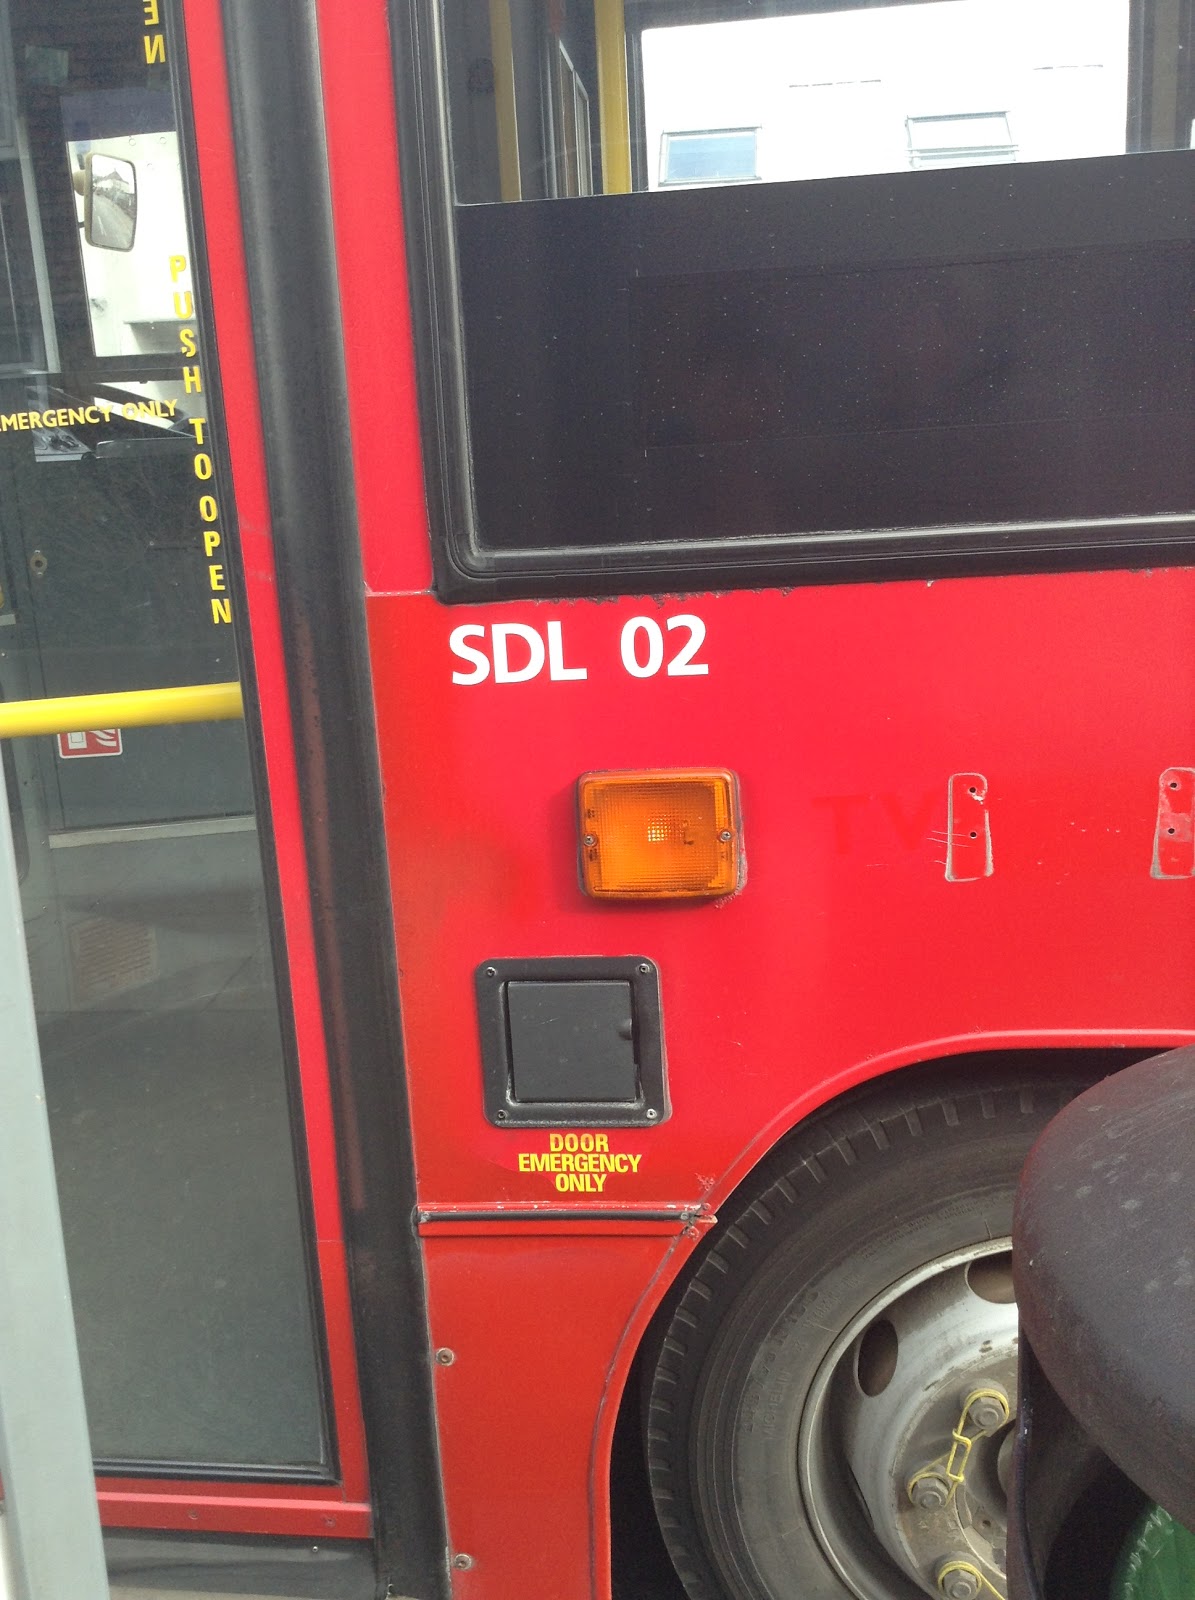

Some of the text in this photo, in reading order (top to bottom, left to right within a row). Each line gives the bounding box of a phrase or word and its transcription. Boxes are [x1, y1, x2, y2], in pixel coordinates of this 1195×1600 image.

[0, 399, 177, 431] MERGENCY ONLY
[169, 255, 232, 624] PUSH TO OPEN
[449, 614, 709, 685] SDL 02
[550, 1133, 609, 1152] DOOR
[518, 1153, 642, 1172] EMERGENCY
[555, 1173, 607, 1192] ONLY
